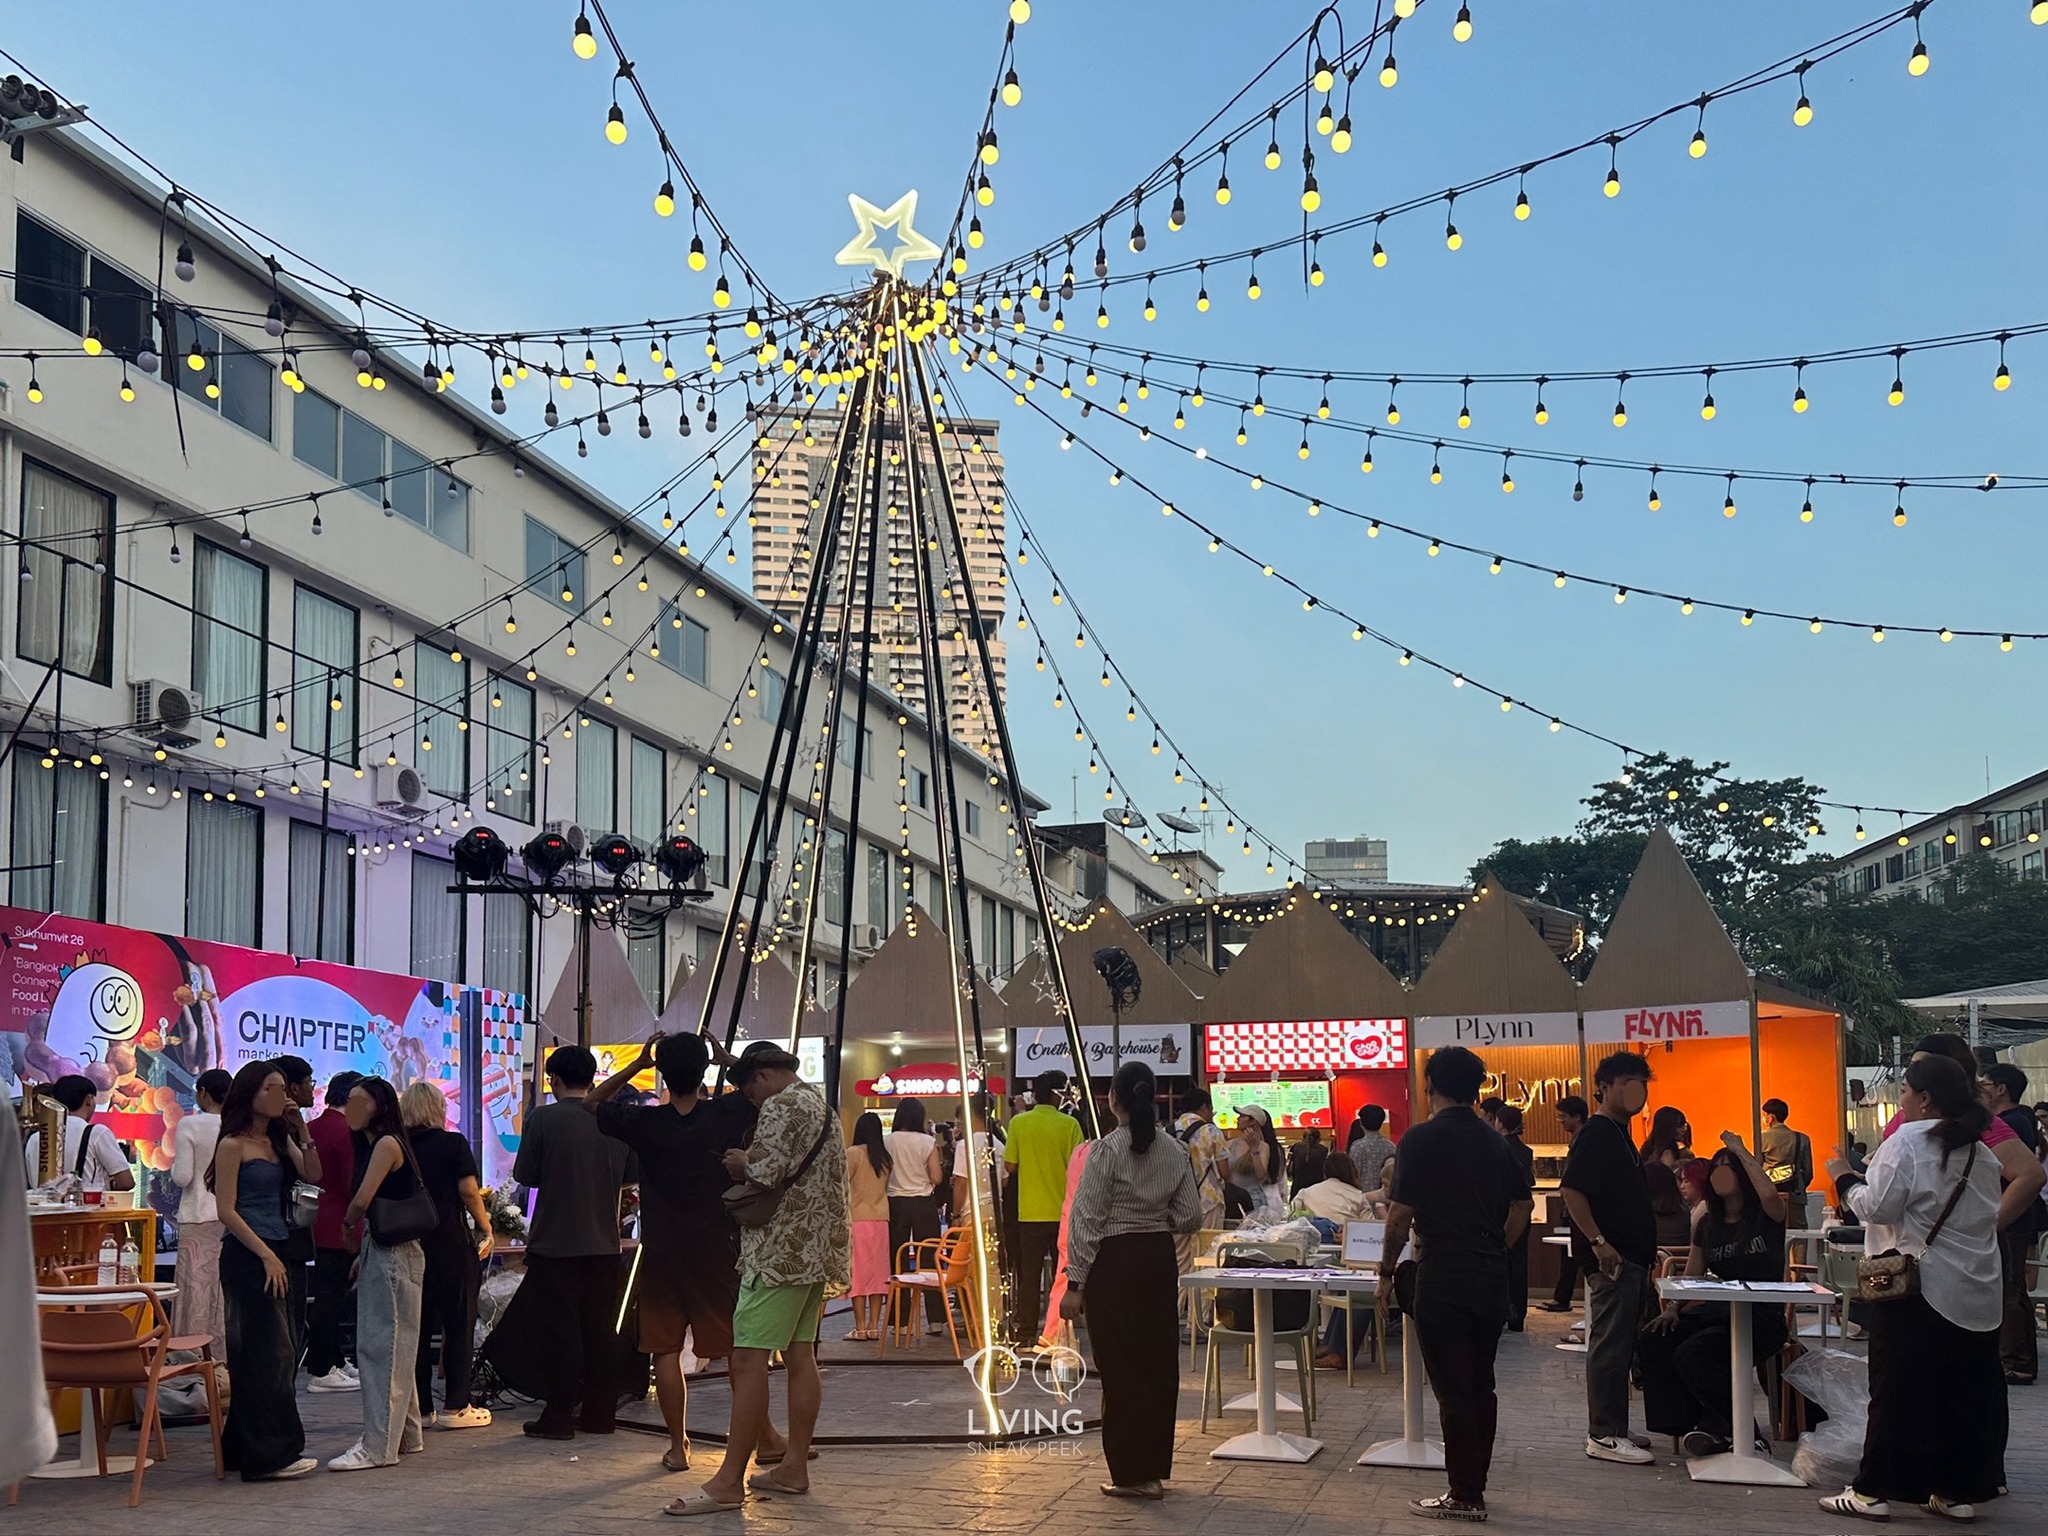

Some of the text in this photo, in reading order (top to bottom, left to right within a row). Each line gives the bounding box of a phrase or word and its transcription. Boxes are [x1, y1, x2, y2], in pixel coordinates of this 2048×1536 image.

[15, 925, 84, 946] Sukhumvit 26
[12, 988, 39, 1002] Food
[11, 1006, 20, 1015] in
[238, 1010, 366, 1054] CHAPTER
[238, 1048, 284, 1062] marke
[1091, 1040, 1160, 1062] Baehouse
[895, 1078, 980, 1095] SHIRO BN
[39, 1122, 49, 1173] SINGHA
